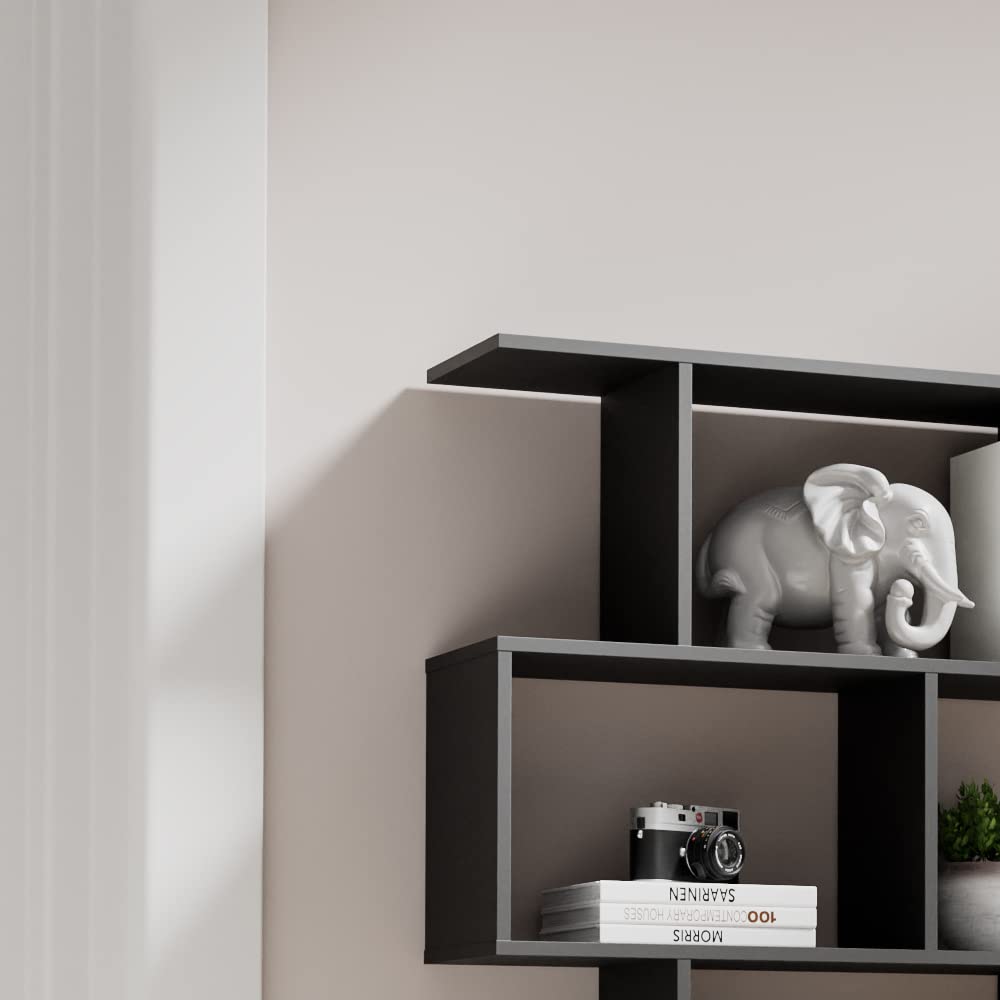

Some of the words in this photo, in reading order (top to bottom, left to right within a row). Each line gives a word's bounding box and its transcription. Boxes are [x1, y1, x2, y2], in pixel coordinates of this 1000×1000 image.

[669, 887, 736, 903] SAARINEN
[624, 907, 664, 921] HOUSES
[747, 911, 776, 923] 100
[673, 929, 723, 943] MORRIS
